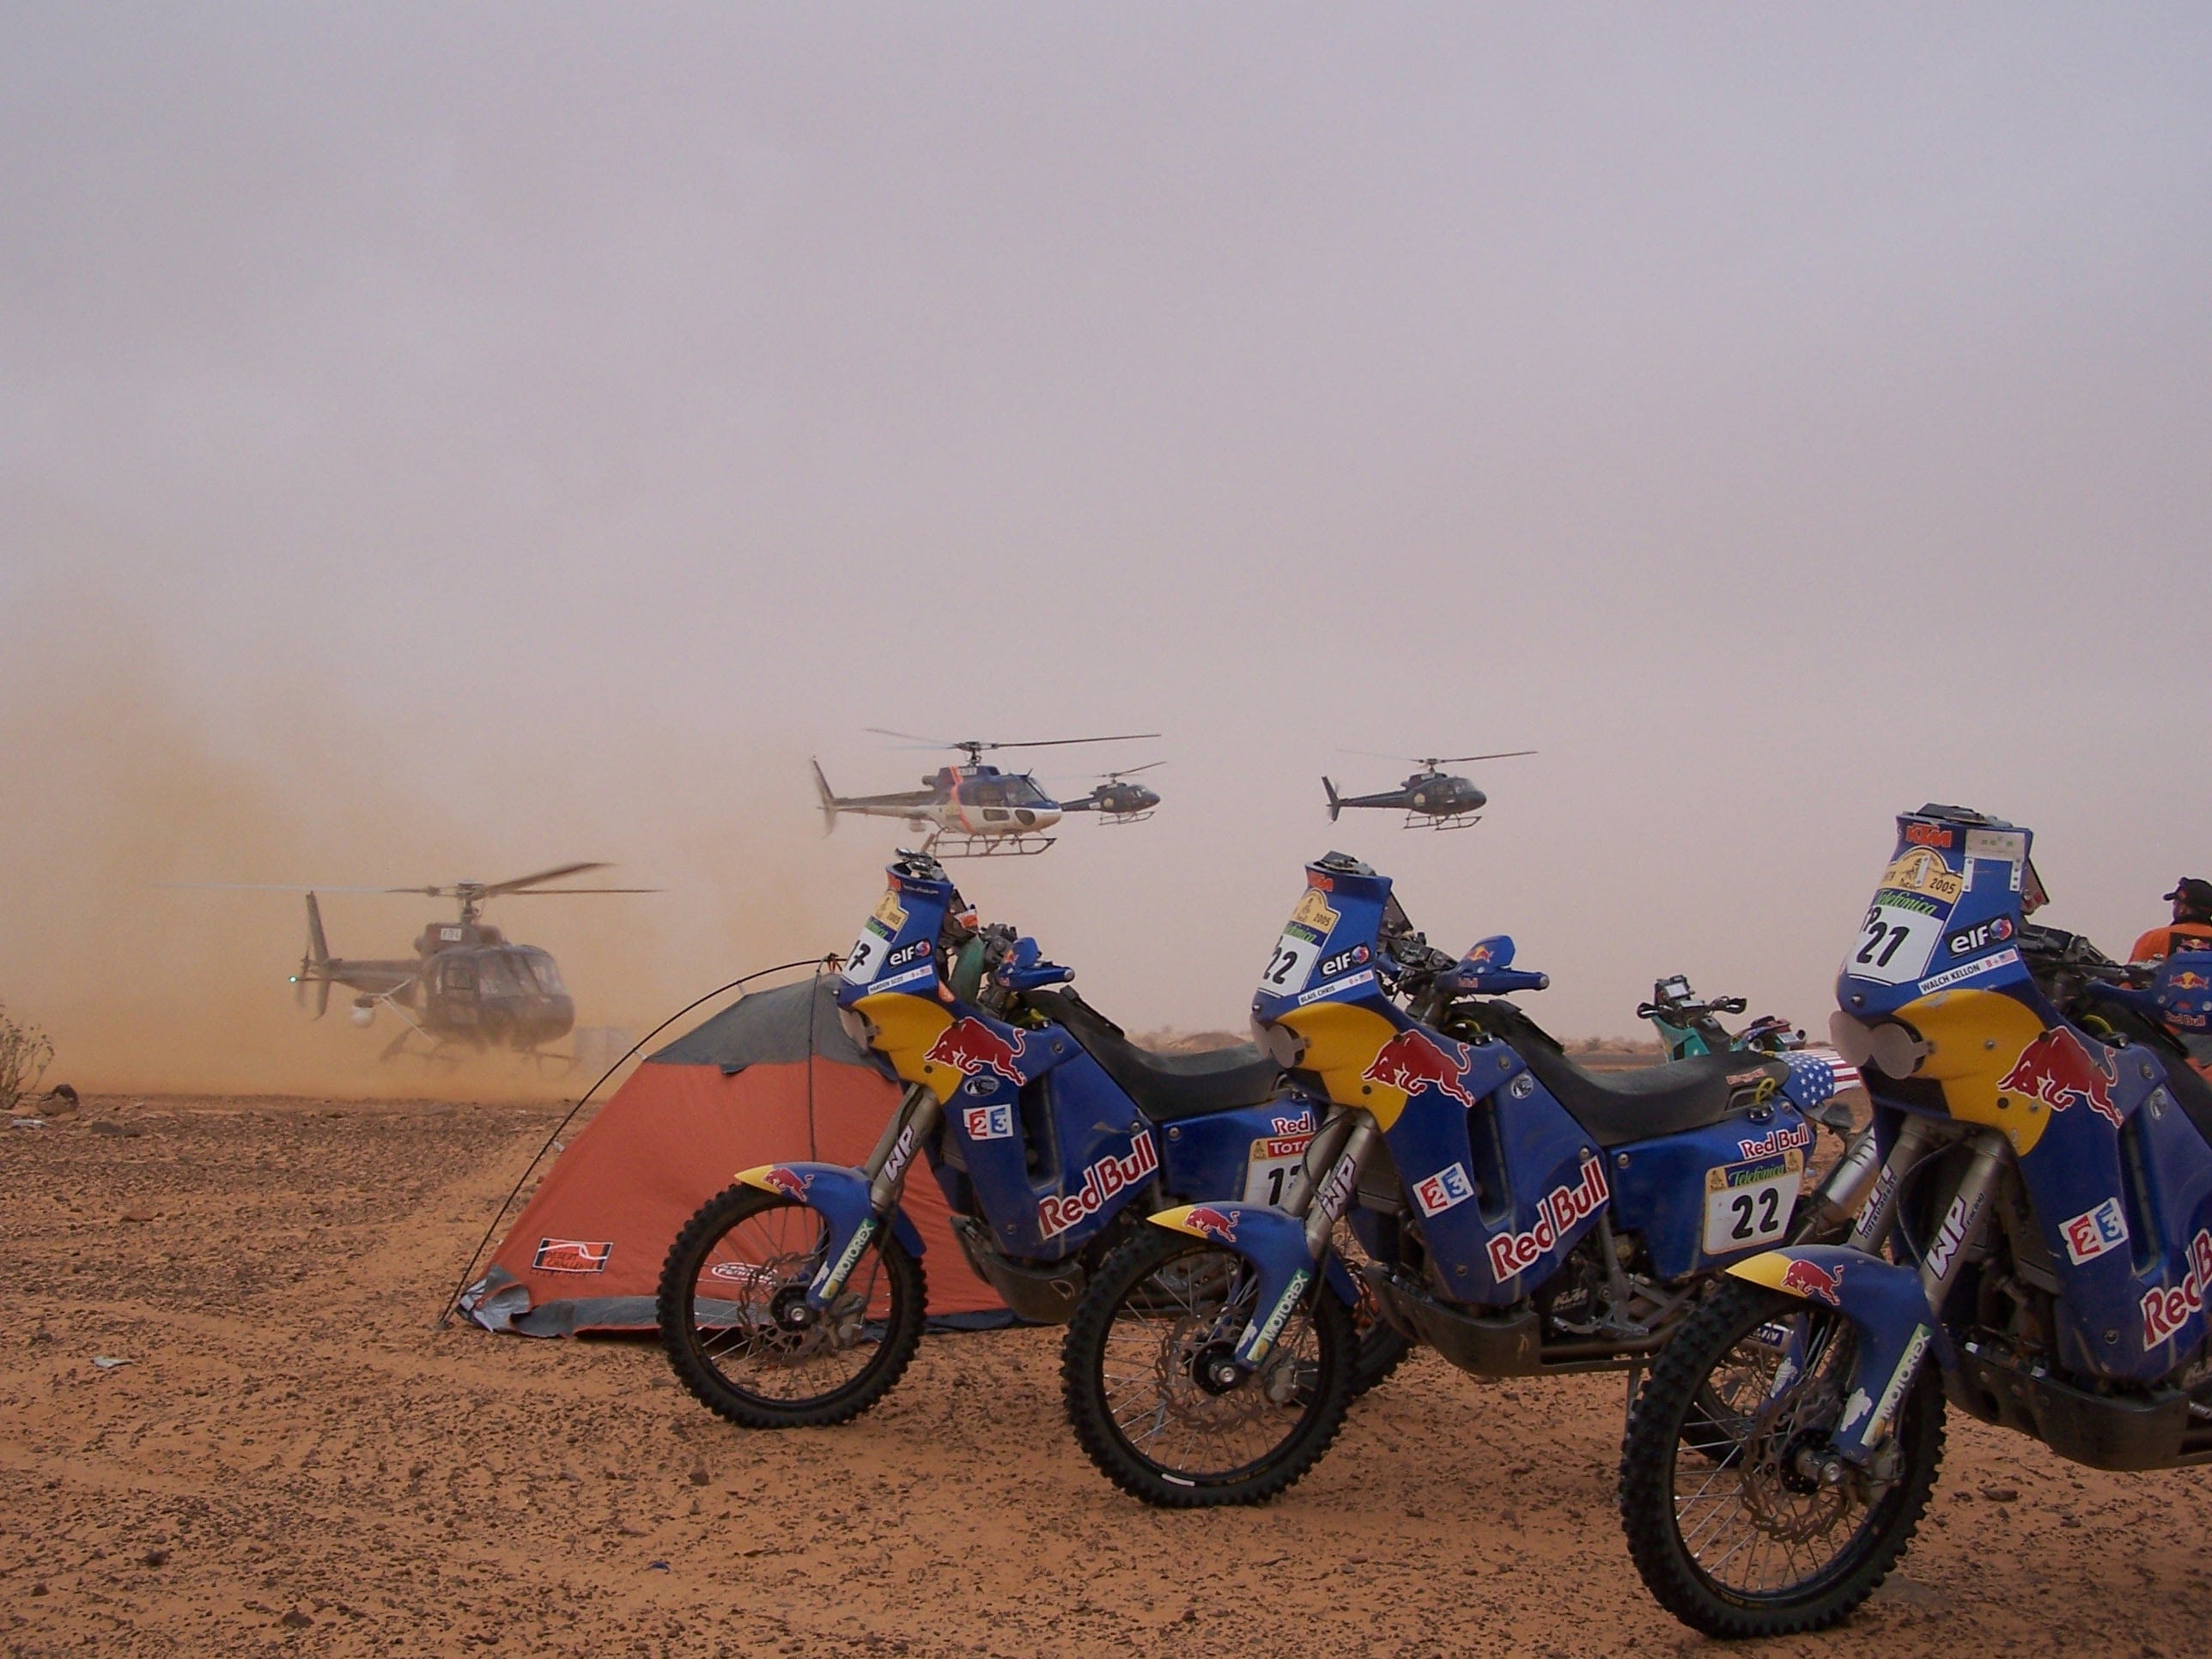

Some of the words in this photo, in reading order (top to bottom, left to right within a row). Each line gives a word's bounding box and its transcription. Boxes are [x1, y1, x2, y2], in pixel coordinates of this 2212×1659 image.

[1906, 823, 1953, 848] KTM
[1929, 878, 1956, 894] 2005
[890, 945, 915, 965] elf
[1856, 921, 1911, 968] 21
[1950, 925, 1989, 954] elf
[1263, 946, 1298, 985] 22
[1322, 952, 1351, 975] elf
[1921, 975, 1950, 992] WALCH
[1950, 963, 1981, 982] KELLON
[1273, 1111, 1310, 1135] Red
[1739, 1131, 1776, 1159] Red
[1777, 1124, 1809, 1150] Bull
[884, 1123, 915, 1183] WP
[1038, 1166, 1102, 1239] Red
[1095, 1130, 1158, 1200] Bull
[1487, 1200, 1556, 1281] Red
[1549, 1156, 1609, 1236] Bull
[1730, 1188, 1779, 1240] 22
[834, 1223, 875, 1282] MOTOREX
[1924, 1194, 1967, 1280] WP
[1264, 1273, 1309, 1342] MOTOREX
